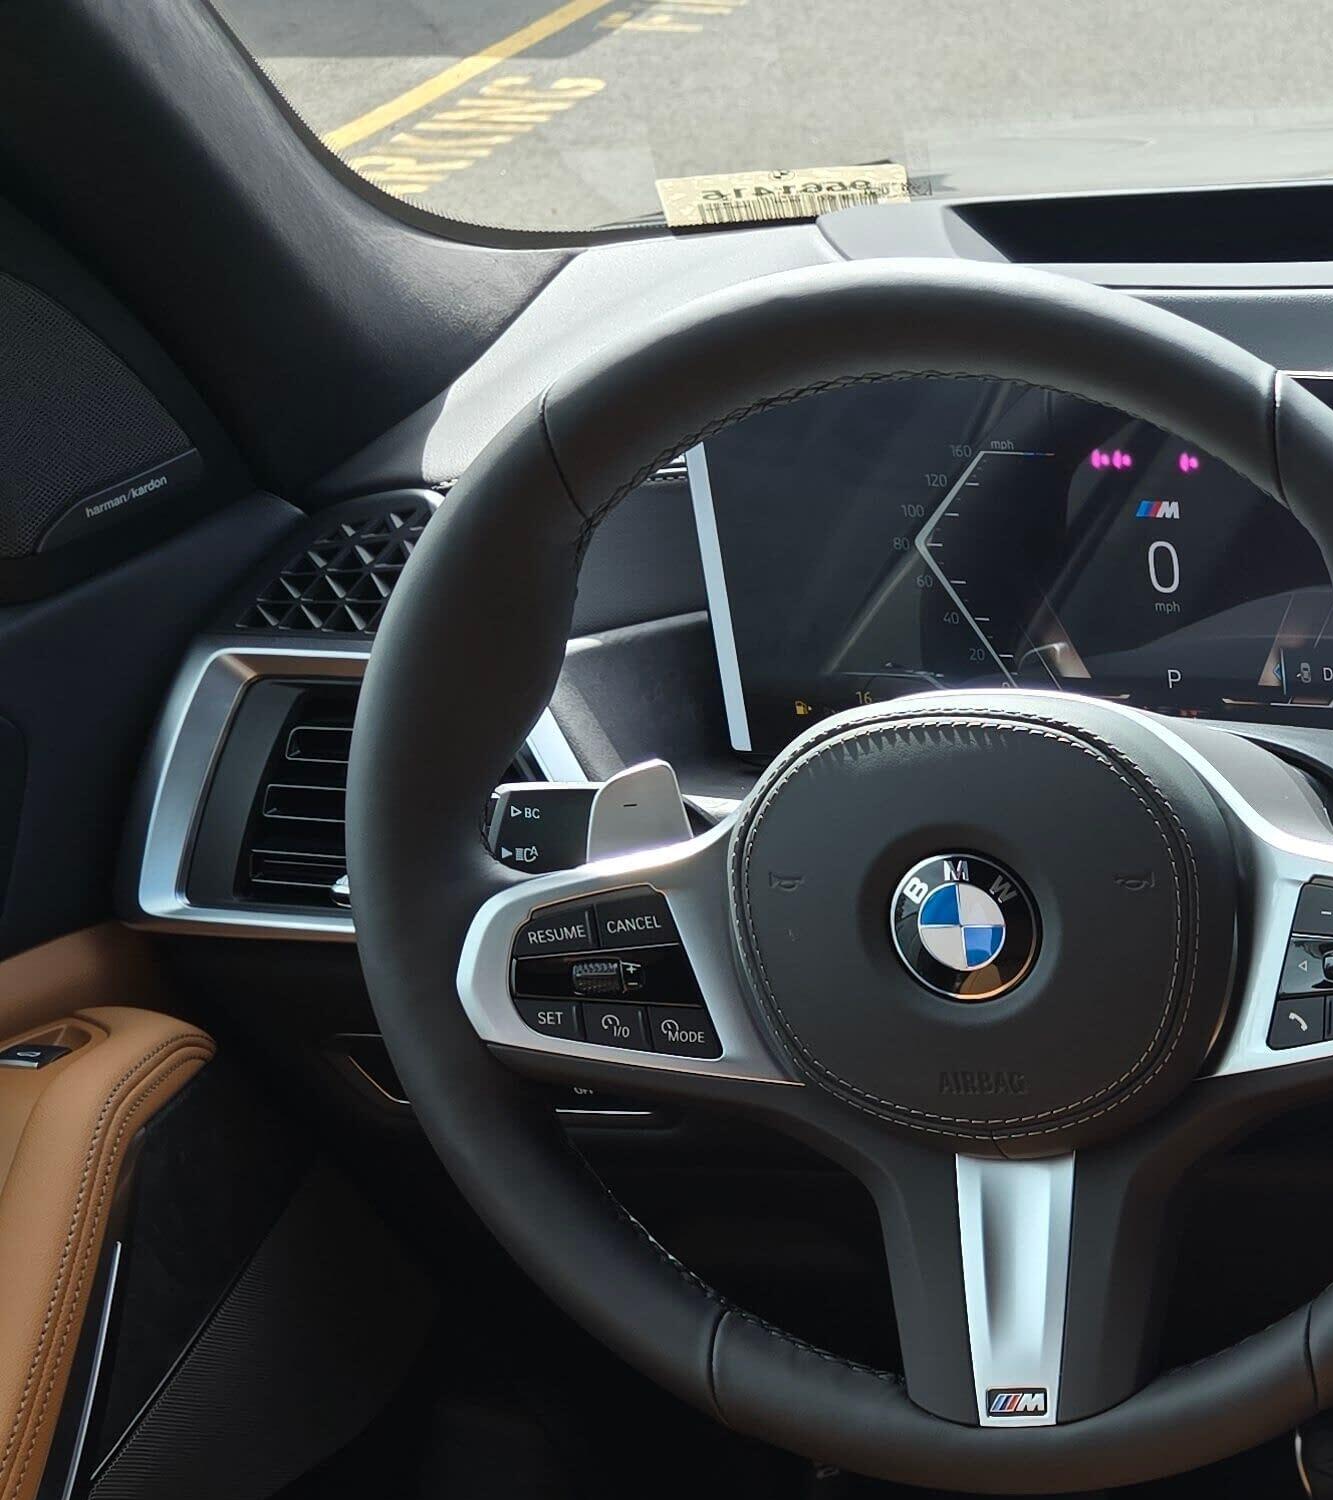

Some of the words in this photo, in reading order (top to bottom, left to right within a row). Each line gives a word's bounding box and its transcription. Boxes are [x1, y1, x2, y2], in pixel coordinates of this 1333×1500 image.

[949, 443, 972, 458] 160
[925, 473, 947, 488] 120
[85, 476, 168, 518] harman/kardon
[901, 504, 925, 518] 100
[893, 536, 910, 551] 80
[1147, 540, 1181, 594] 0
[916, 574, 933, 589] 60
[1154, 600, 1181, 615] mph
[943, 611, 959, 625] 40
[969, 648, 985, 662] 20
[1168, 669, 1182, 688] P
[524, 808, 541, 819] BC
[903, 860, 1018, 904] BMW
[607, 916, 661, 934] CANCEL
[528, 925, 586, 945] RESUME
[537, 1011, 563, 1025] SET
[668, 1031, 705, 1044] MODE
